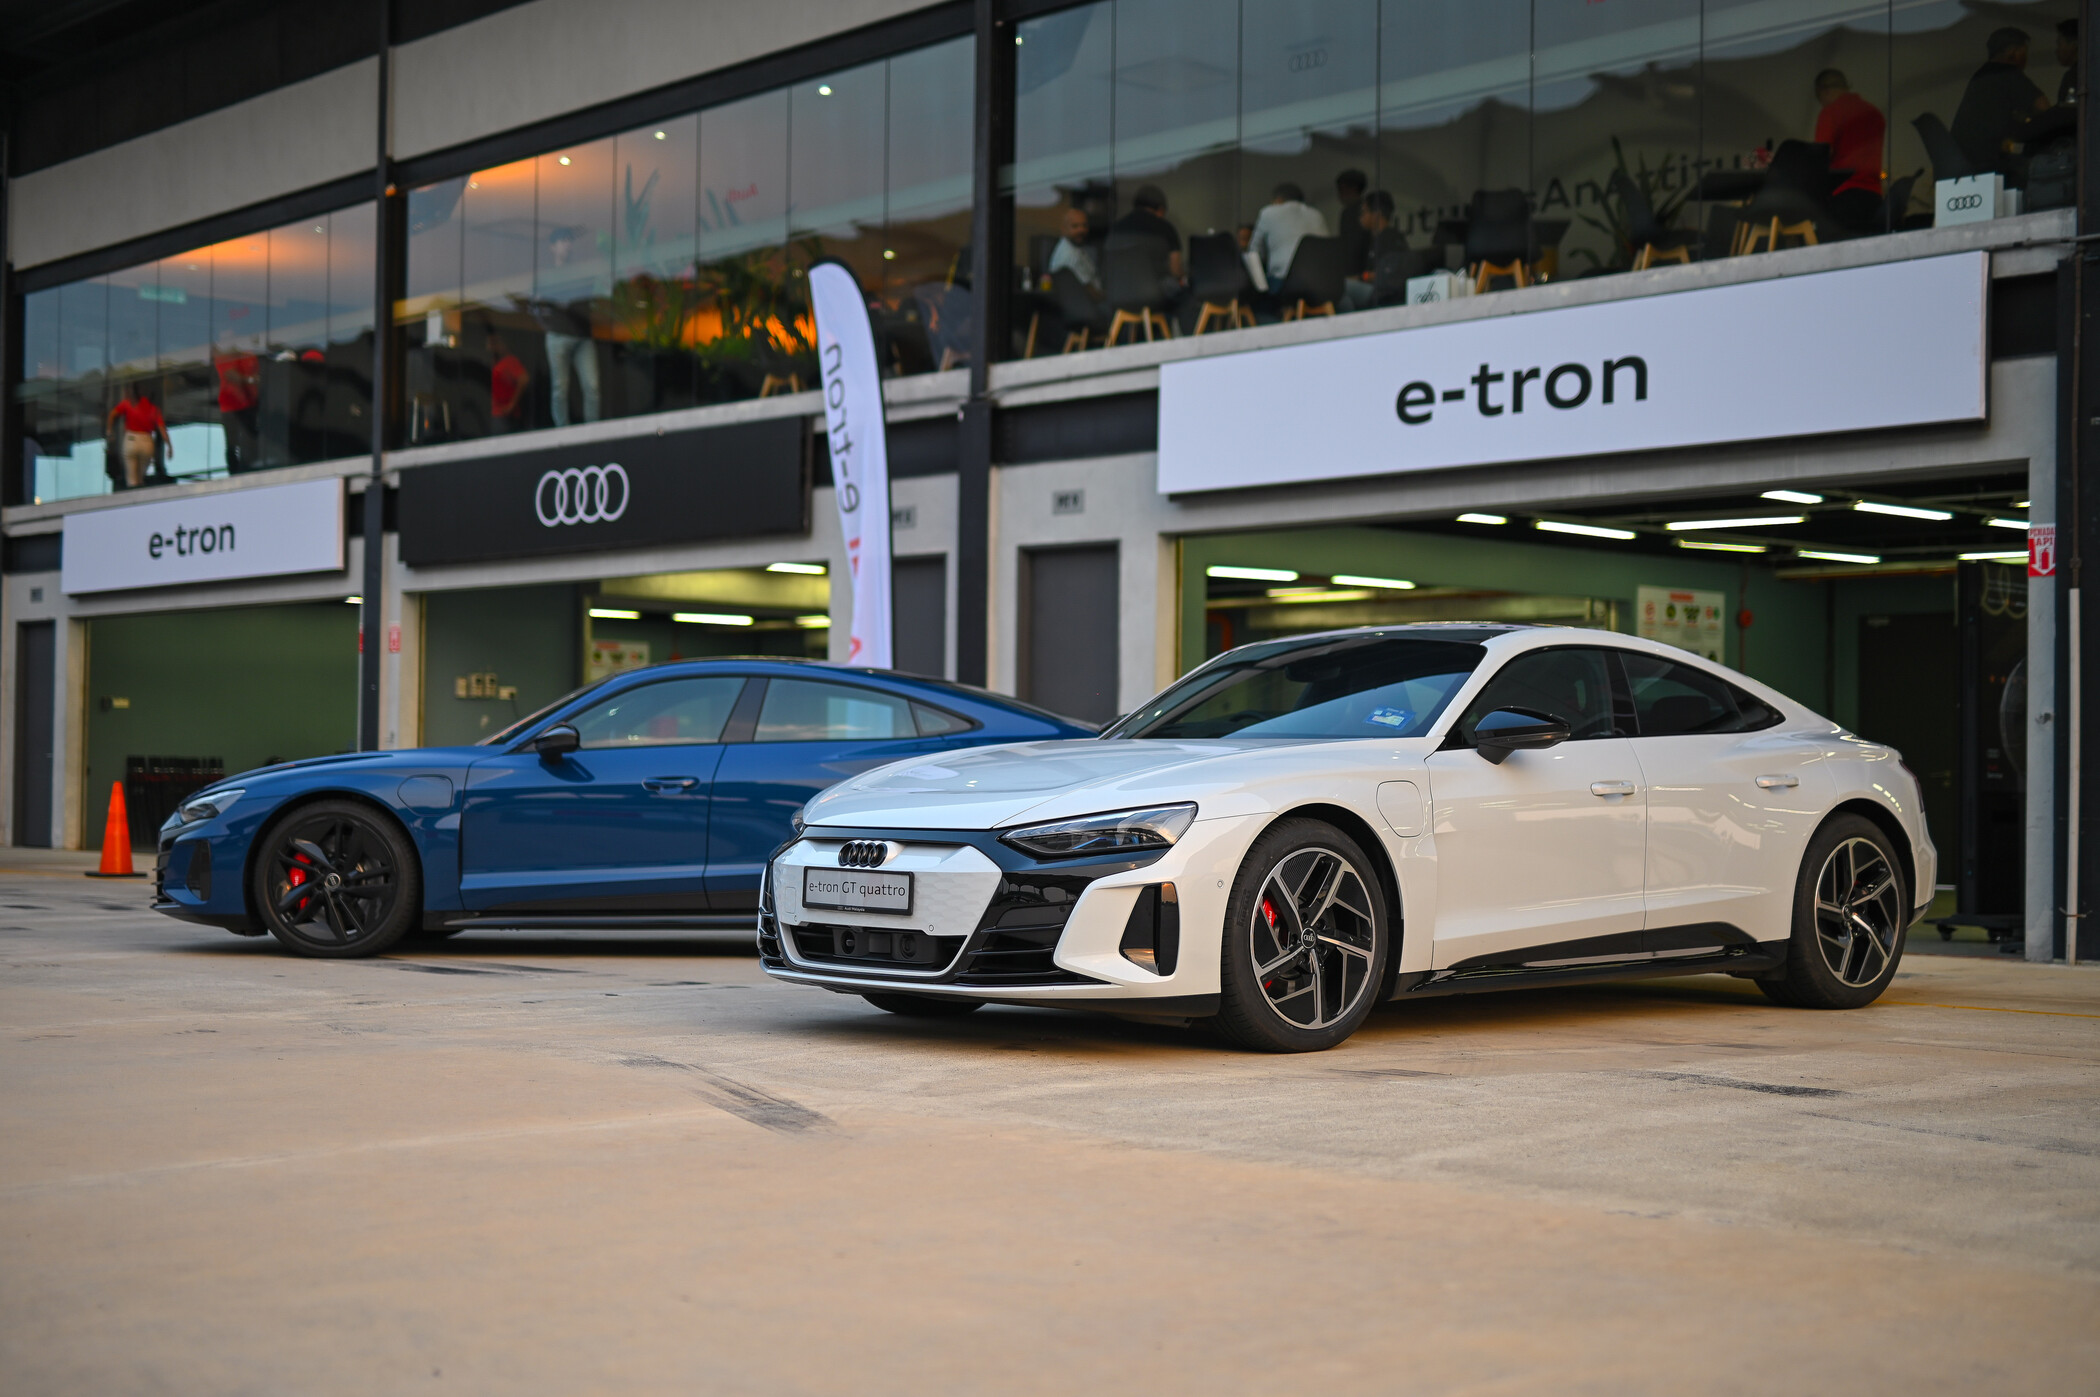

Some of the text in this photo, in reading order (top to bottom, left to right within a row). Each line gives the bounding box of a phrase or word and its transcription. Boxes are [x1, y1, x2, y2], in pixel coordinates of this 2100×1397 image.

[1395, 355, 1648, 426] e-tron
[148, 523, 236, 560] e-tron
[2036, 537, 2053, 546] API
[809, 881, 906, 898] e-tron GT quattro
